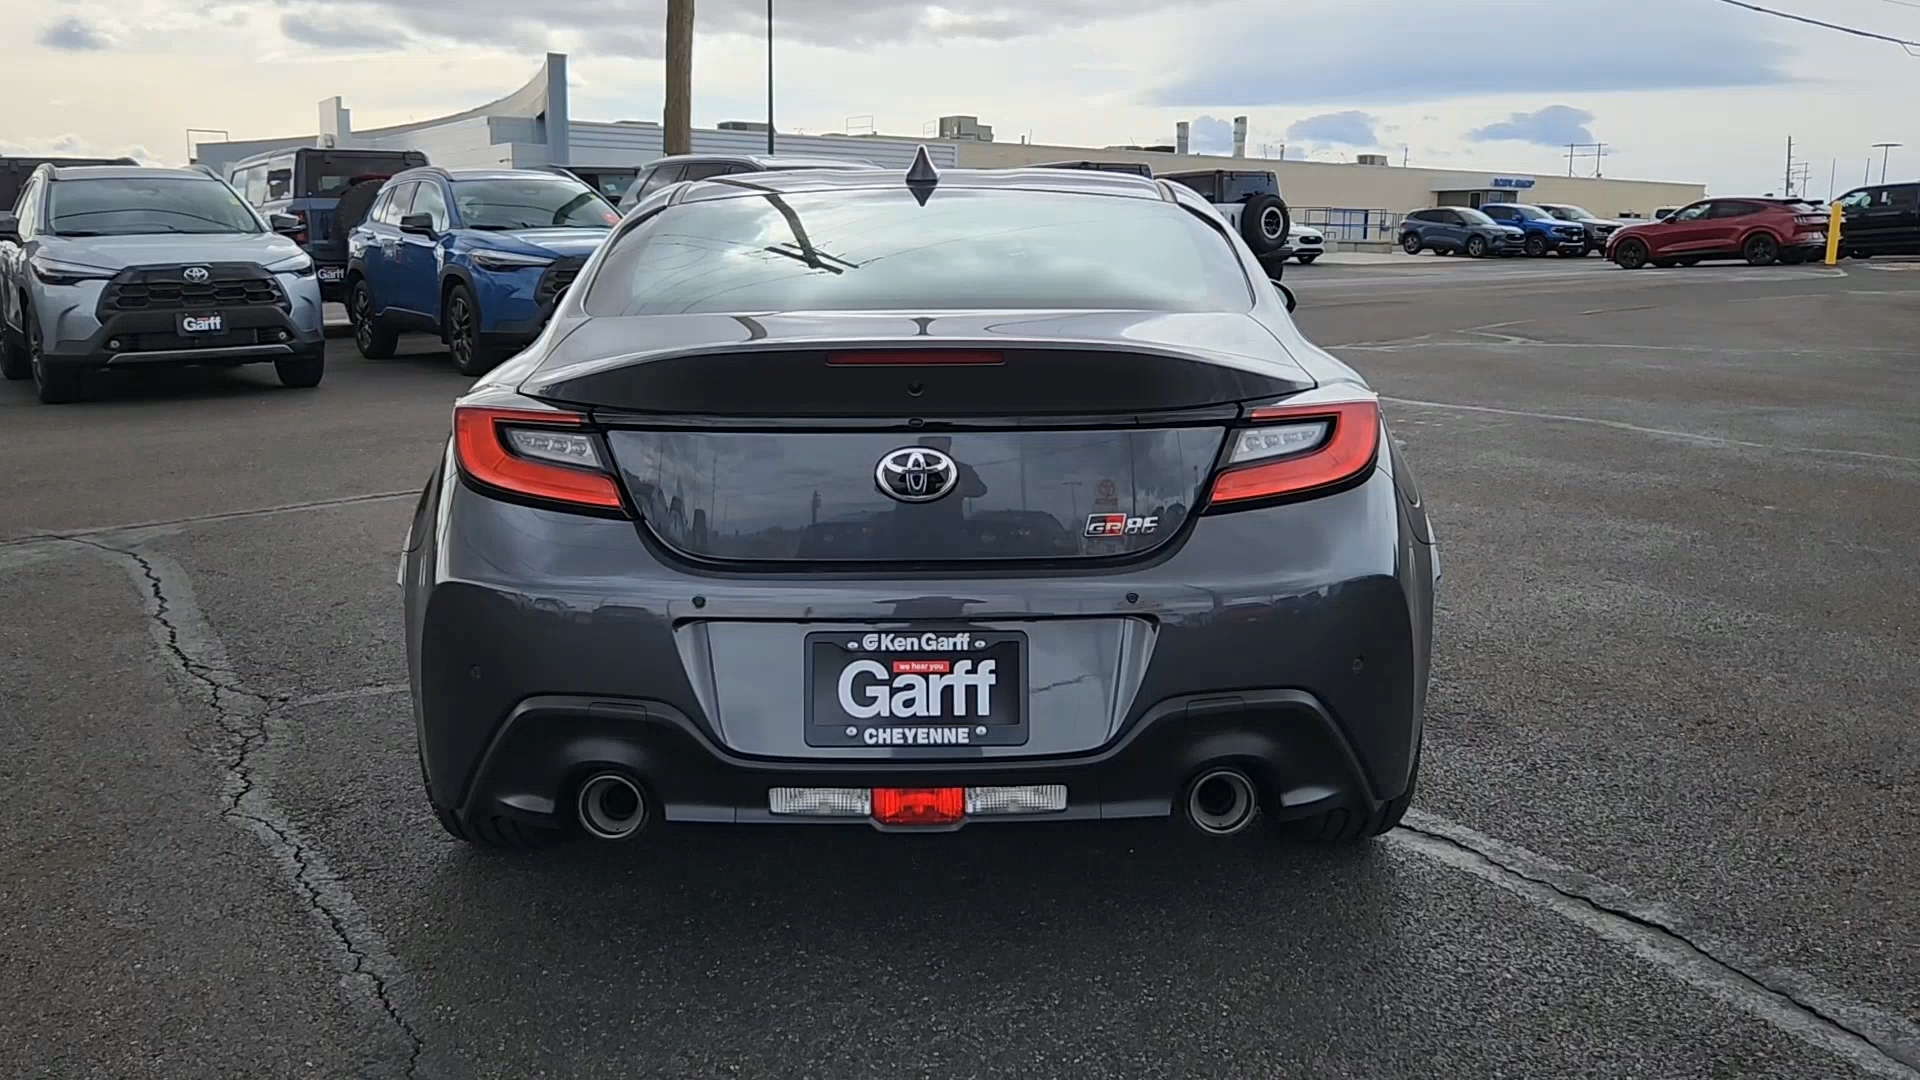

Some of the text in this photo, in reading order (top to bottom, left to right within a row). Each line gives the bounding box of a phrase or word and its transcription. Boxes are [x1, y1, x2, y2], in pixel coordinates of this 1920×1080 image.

[317, 268, 345, 280] Garff
[183, 316, 222, 332] Garff
[880, 632, 970, 651] Ken Garff
[911, 662, 928, 670] hear
[929, 663, 944, 671] you
[838, 659, 996, 719] Garff
[863, 727, 970, 745] CHEYENNE
